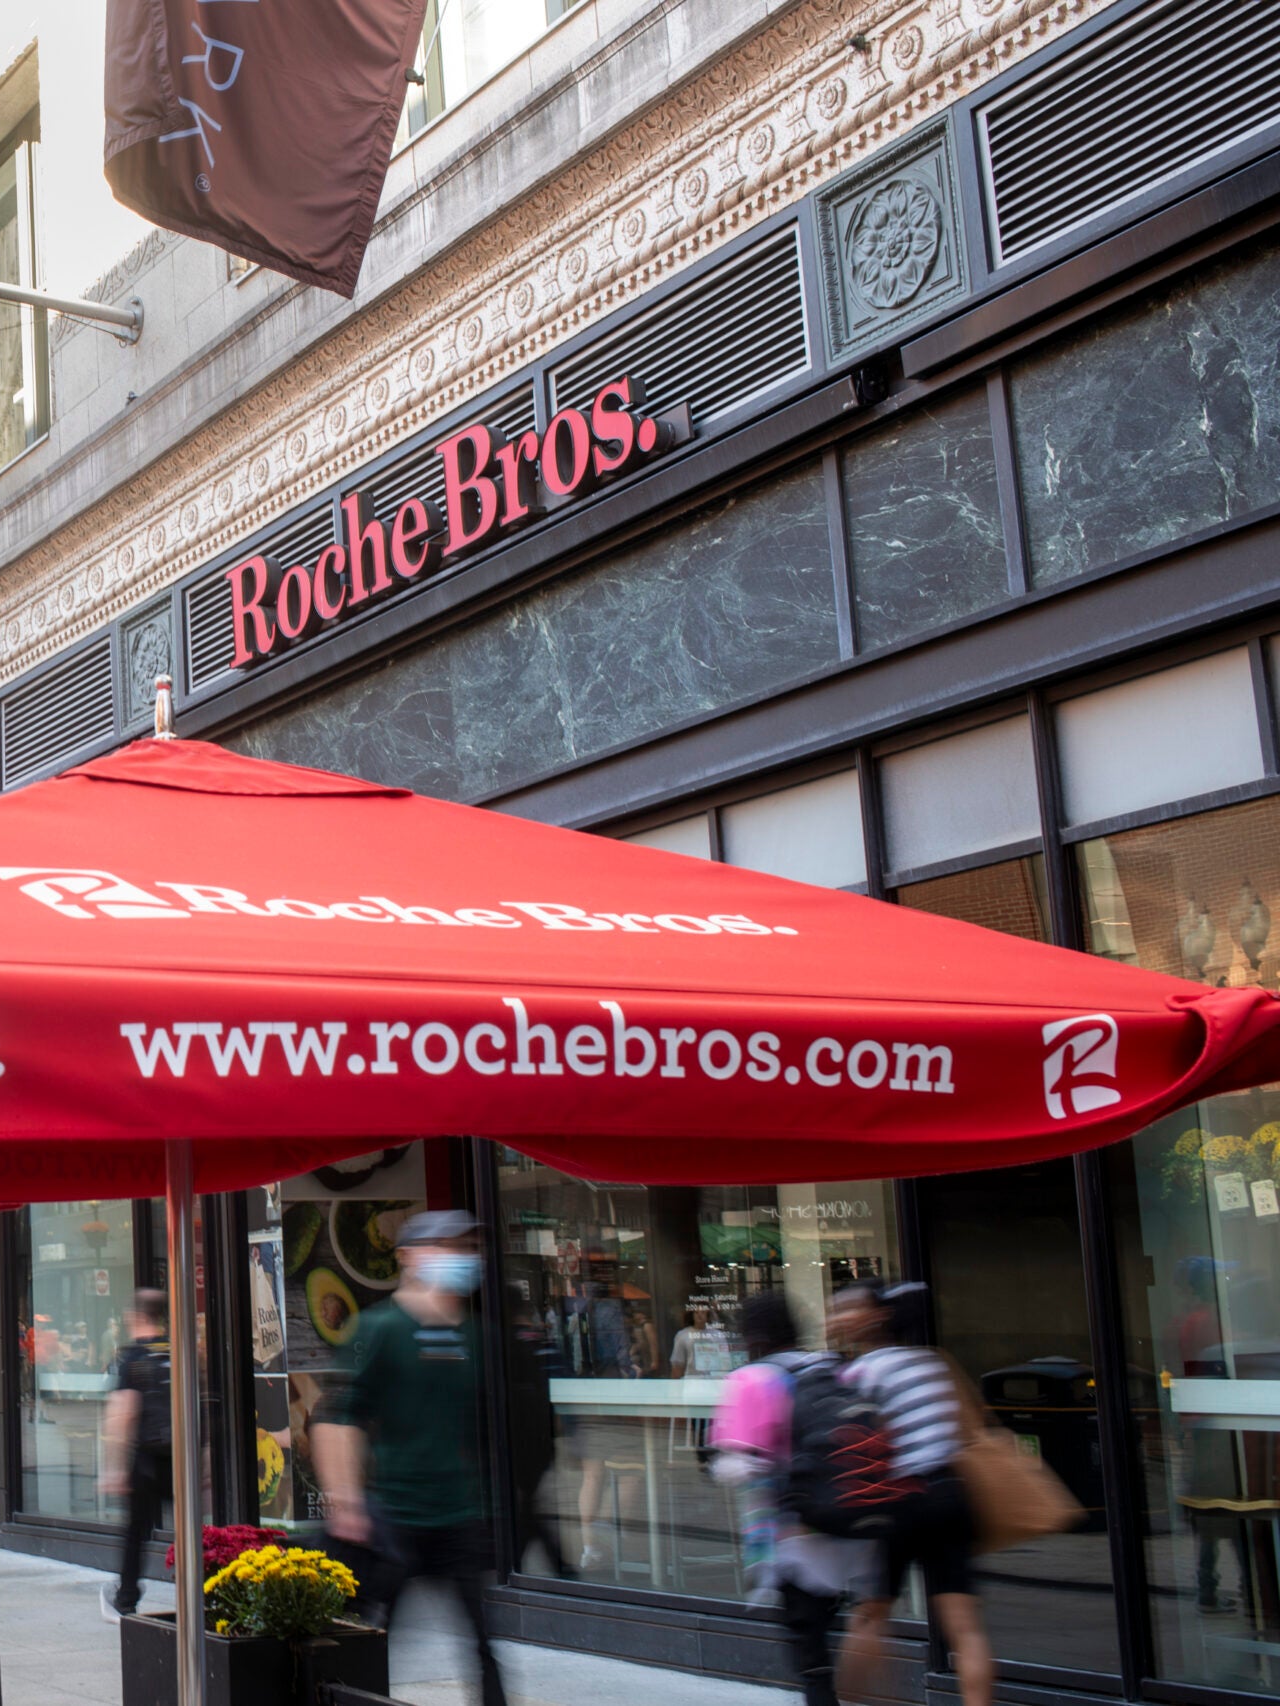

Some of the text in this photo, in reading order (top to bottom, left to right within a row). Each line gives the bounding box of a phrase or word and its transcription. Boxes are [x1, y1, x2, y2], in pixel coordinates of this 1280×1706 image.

[159, 0, 246, 169] RK
[226, 375, 657, 669] Roche Bros.
[155, 881, 522, 928] Roche
[499, 901, 799, 935] Bros.
[120, 997, 955, 1093] www.rochebros.com
